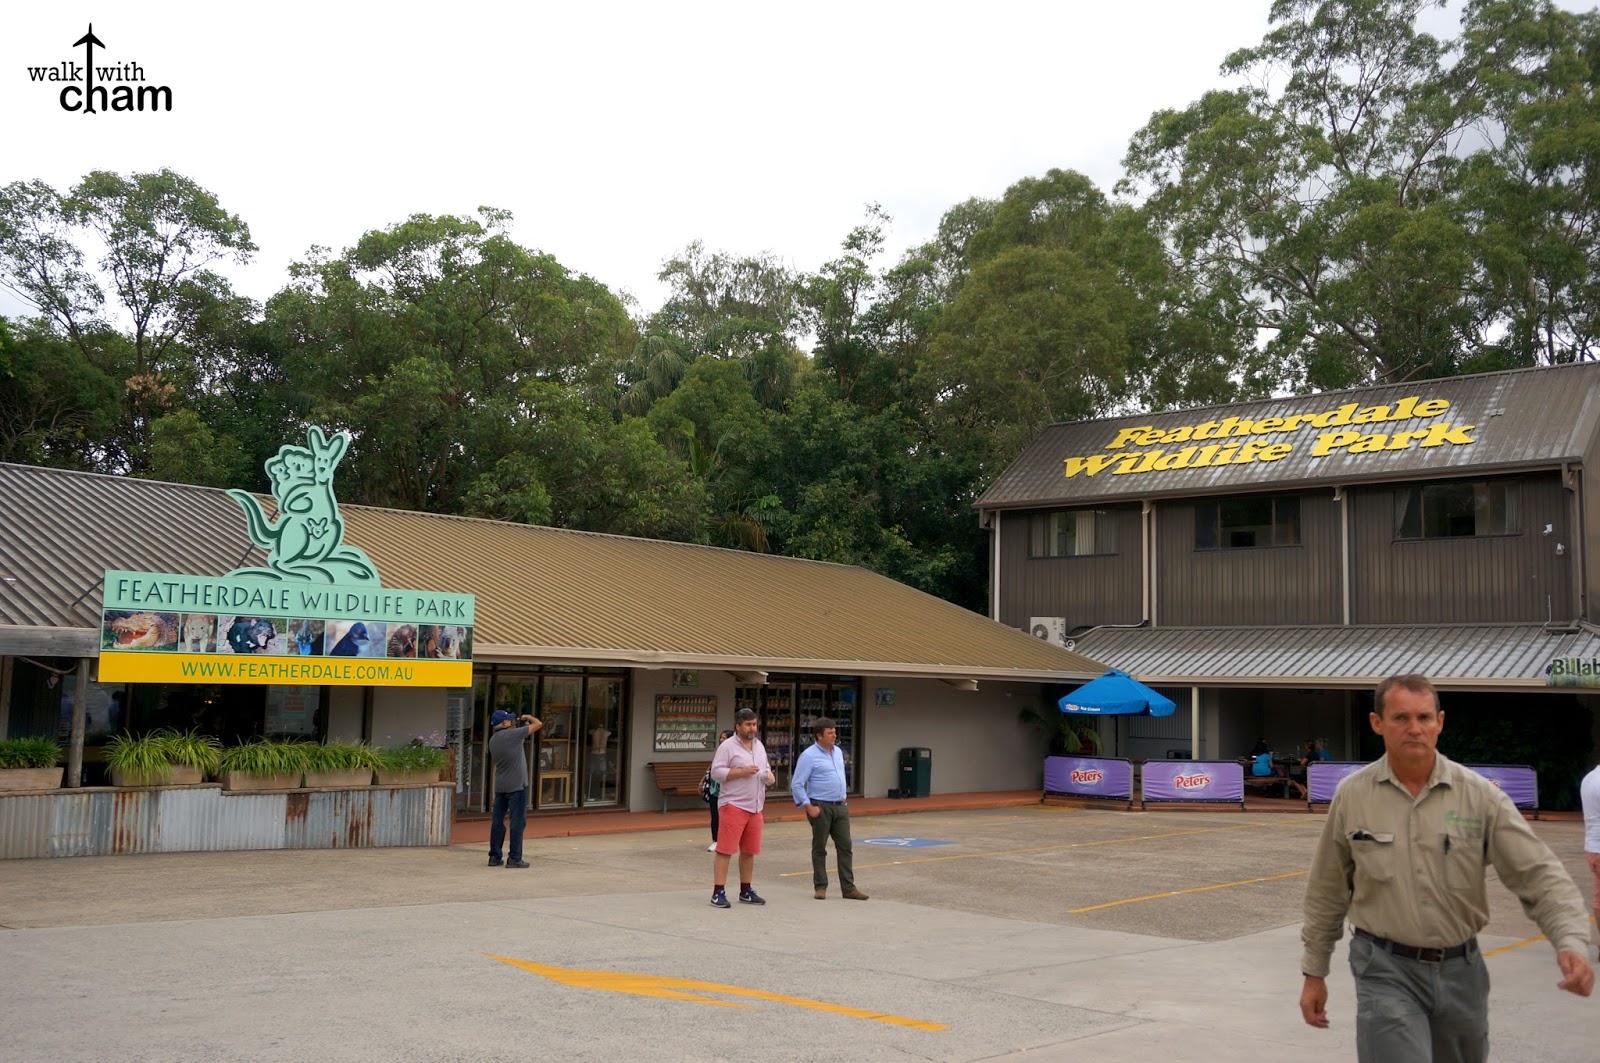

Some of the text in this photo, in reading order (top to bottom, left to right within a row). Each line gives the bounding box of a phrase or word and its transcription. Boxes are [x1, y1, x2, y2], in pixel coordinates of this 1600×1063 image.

[1105, 395, 1451, 450] Featherdale
[1063, 422, 1476, 478] Wildlife Park
[117, 578, 466, 618] FEATHERDALE WILDLIFE PARK
[181, 660, 414, 681] WWW.FEATHERDALE.COM.AU
[1070, 769, 1103, 784] Peters
[1174, 773, 1211, 790] Peters
